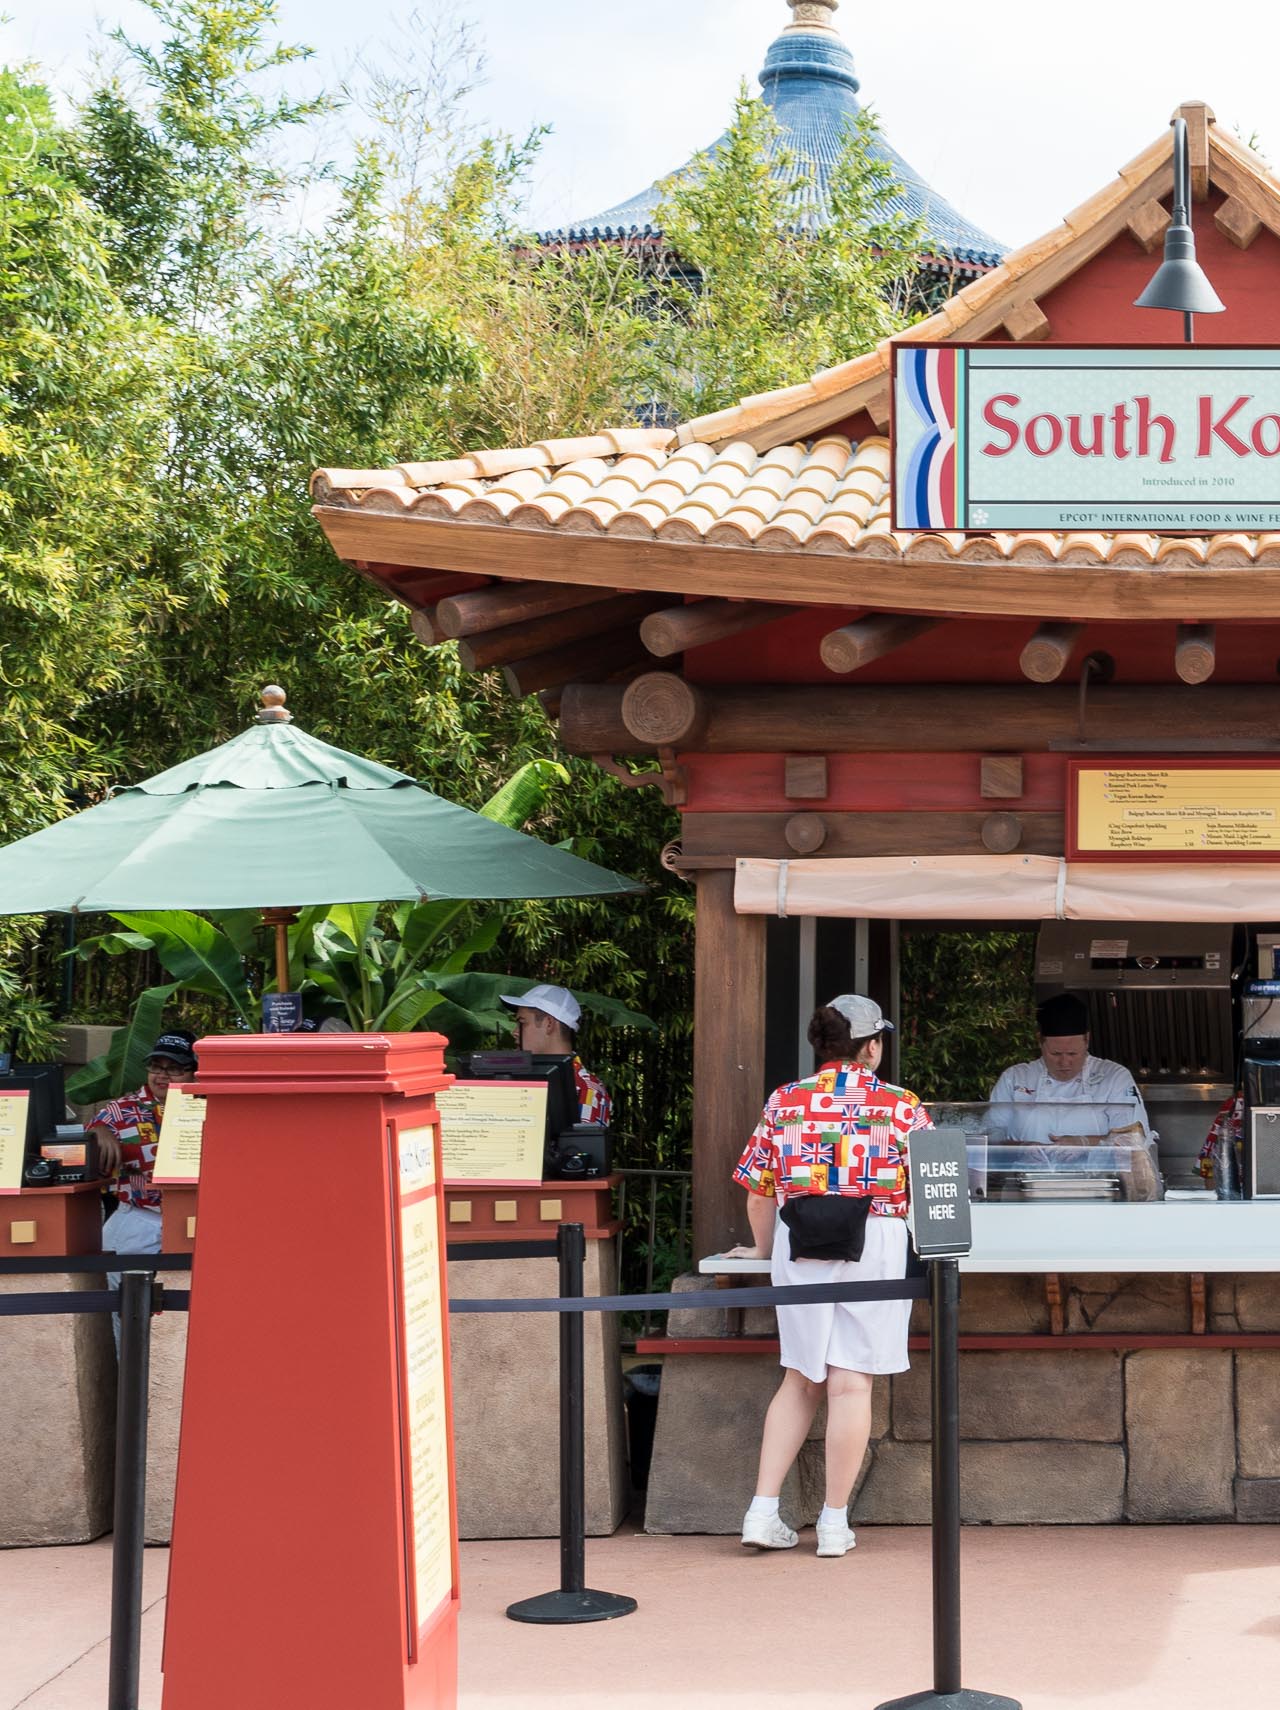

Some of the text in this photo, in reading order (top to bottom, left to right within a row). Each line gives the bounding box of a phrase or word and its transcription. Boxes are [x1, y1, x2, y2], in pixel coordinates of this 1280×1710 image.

[979, 392, 1176, 464] South
[1142, 476, 1235, 486] Introduced in 2010
[1101, 513, 1186, 522] INTERNATIONAL
[1190, 513, 1221, 522] FOOD
[1224, 513, 1232, 522] &
[1236, 513, 1265, 522] WINE
[920, 1161, 959, 1178] PLEASE
[924, 1183, 958, 1199] ENTER
[928, 1204, 956, 1220] HERE
